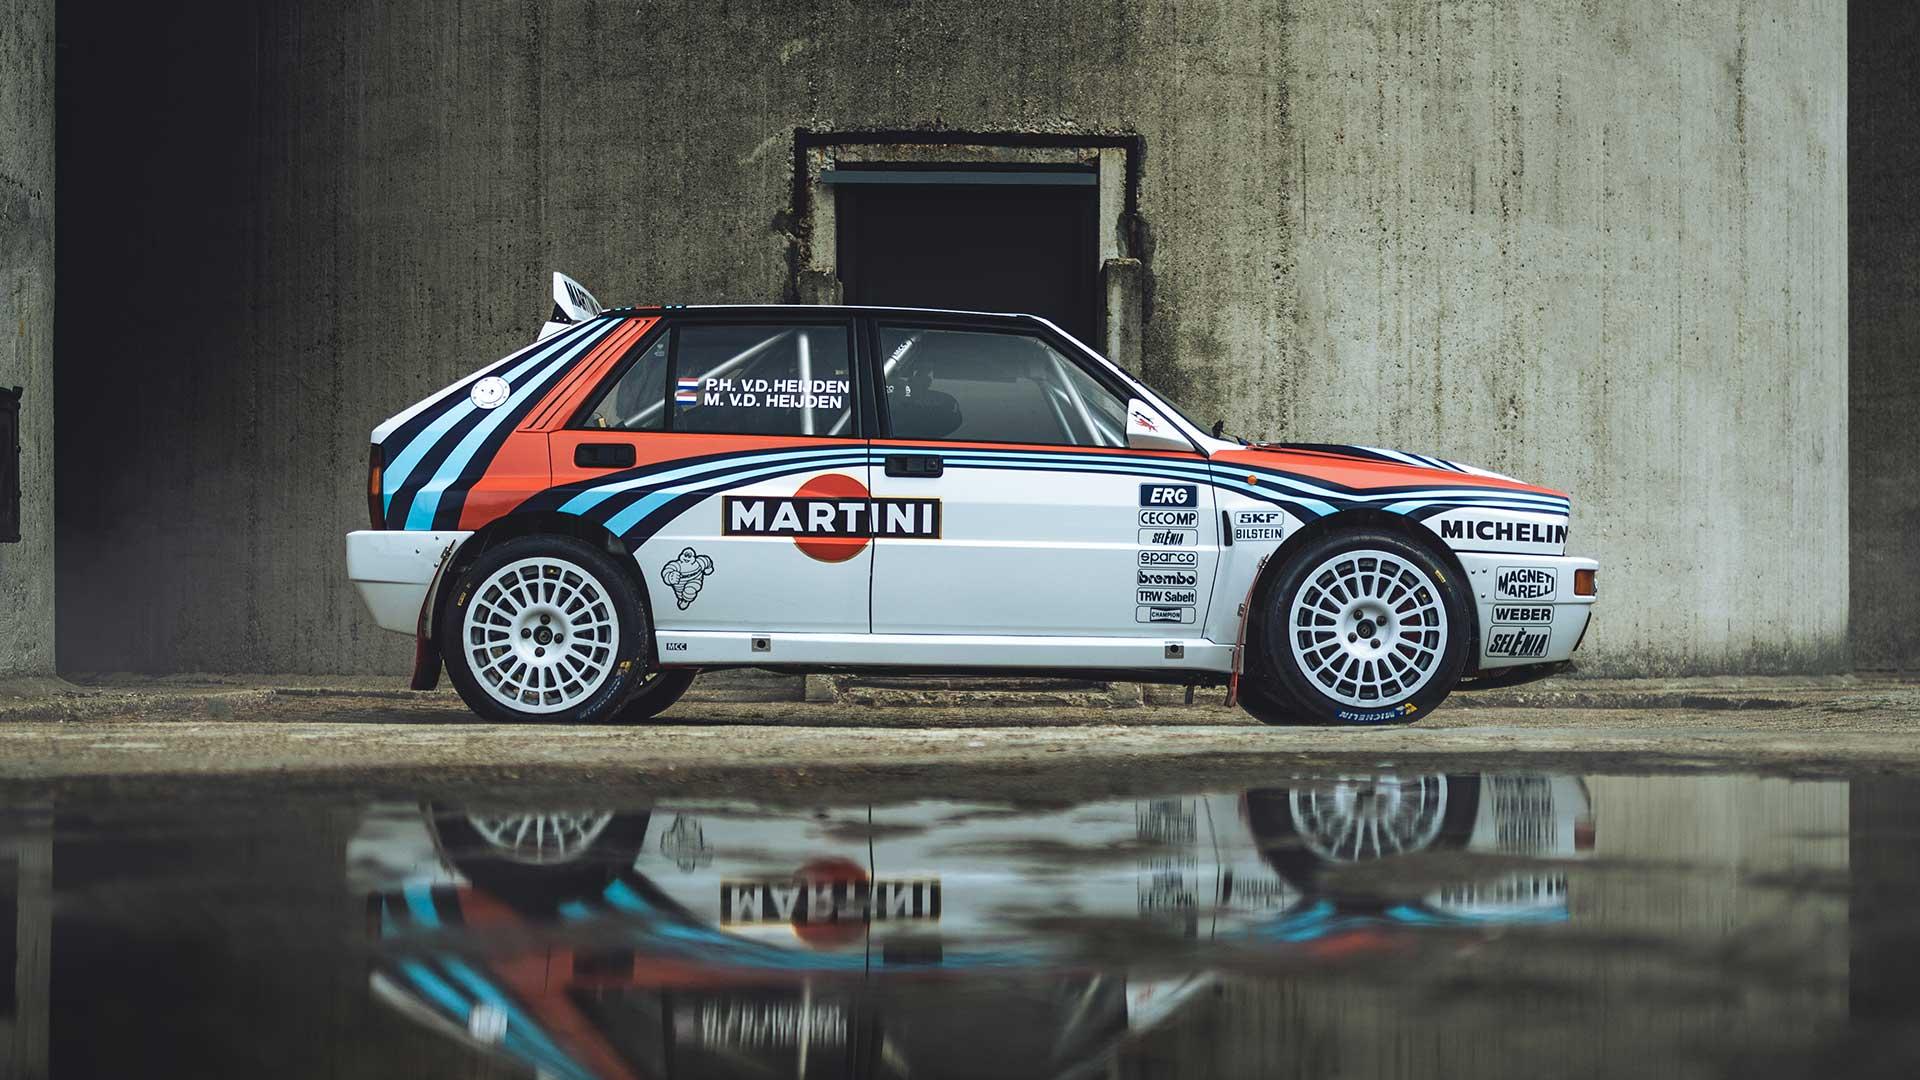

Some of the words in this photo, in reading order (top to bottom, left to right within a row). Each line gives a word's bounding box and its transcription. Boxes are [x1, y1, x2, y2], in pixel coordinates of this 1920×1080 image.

[705, 378, 736, 392] P.H.
[704, 393, 725, 407] M.
[729, 394, 761, 407] V.D.
[765, 394, 842, 409] HEIJDEN
[1150, 487, 1189, 504] ERG
[731, 500, 934, 534] MARTINI
[1140, 512, 1197, 526] CECOMP
[1239, 513, 1279, 524] SKF
[1236, 528, 1282, 539] BILSTEIN
[1440, 519, 1568, 544] MICHELIN
[1140, 552, 1195, 566] sparco
[1139, 571, 1196, 585] brembo
[1138, 591, 1163, 602] TRW
[1164, 591, 1195, 603] Sabelt
[1495, 608, 1551, 621] WEBER
